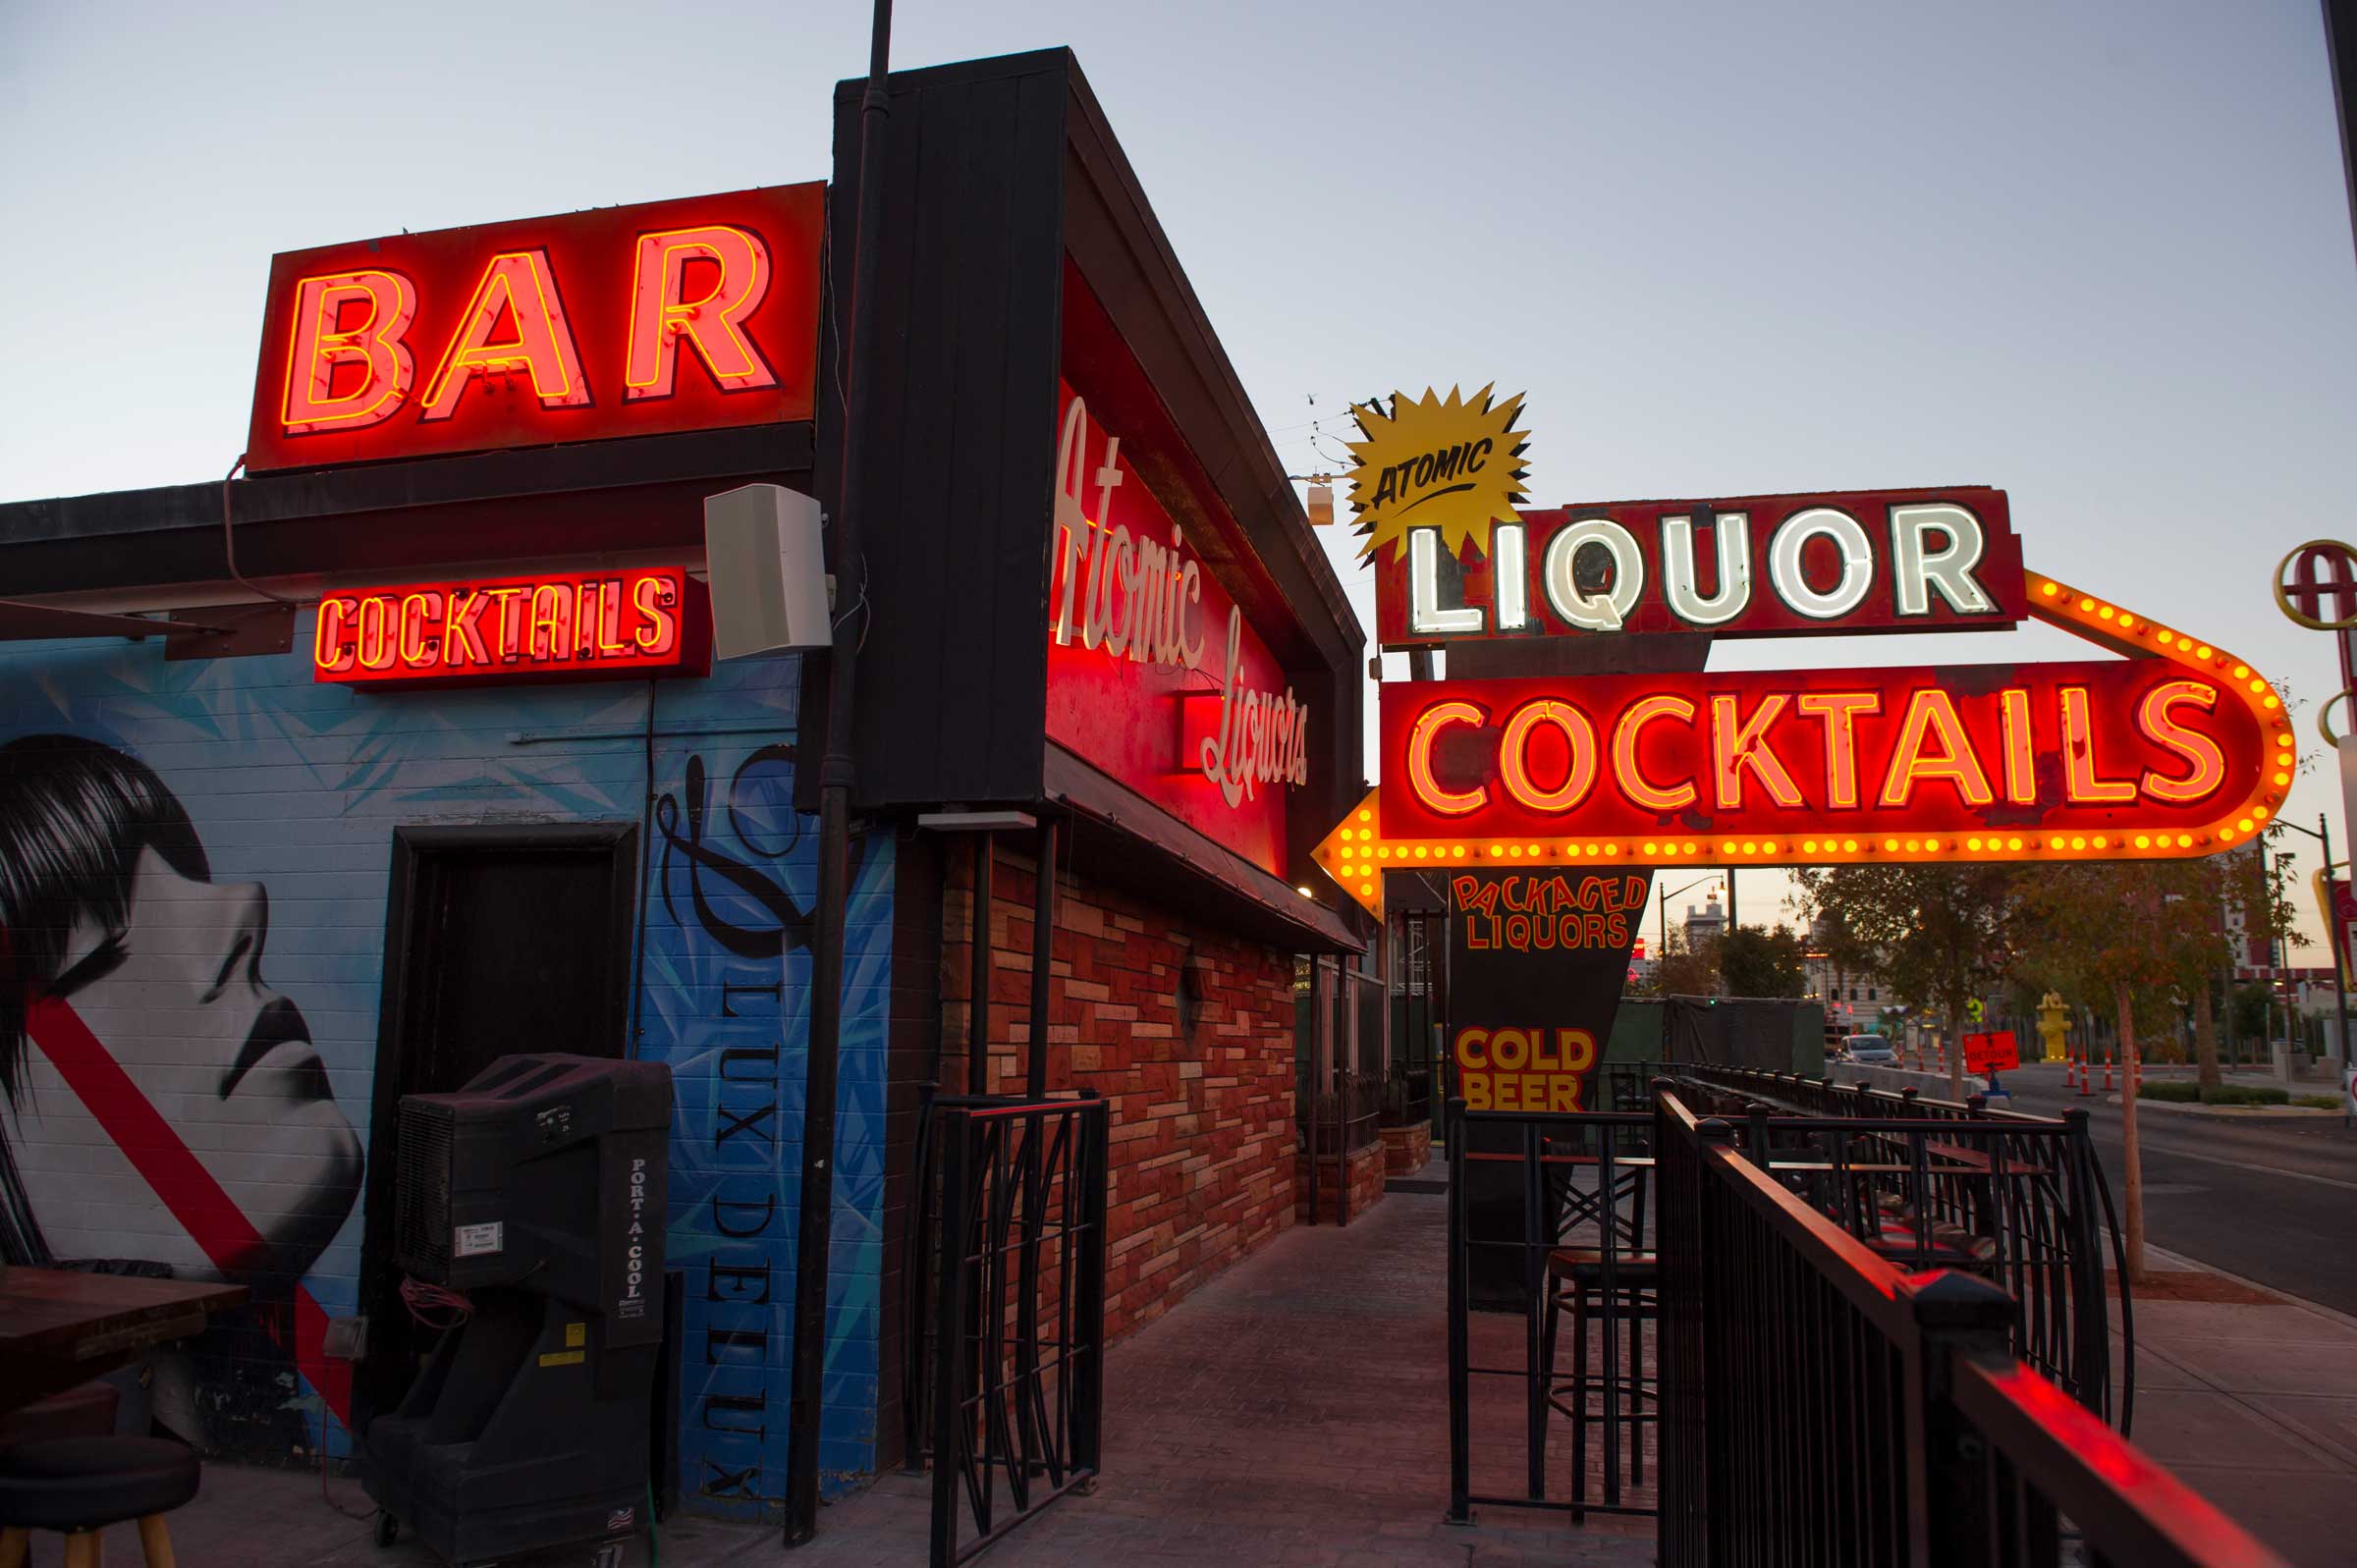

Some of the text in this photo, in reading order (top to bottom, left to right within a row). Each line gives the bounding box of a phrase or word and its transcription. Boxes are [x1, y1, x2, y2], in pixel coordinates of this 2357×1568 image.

[283, 222, 786, 438] BAR
[1370, 437, 1494, 510] ATOMIC
[1050, 396, 1205, 670] Atomic
[1407, 499, 2005, 634] LIQUOR
[313, 574, 680, 672] COCKTAILS
[1199, 604, 1309, 809] Liquors
[1406, 676, 2229, 817] COCKTAILS
[1453, 875, 1648, 918] PACKAGED
[1467, 913, 1629, 952] LIQUORS
[1453, 1026, 1598, 1073] COLD
[1458, 1071, 1584, 1111] BEER
[1969, 1048, 2012, 1061] DETOUR
